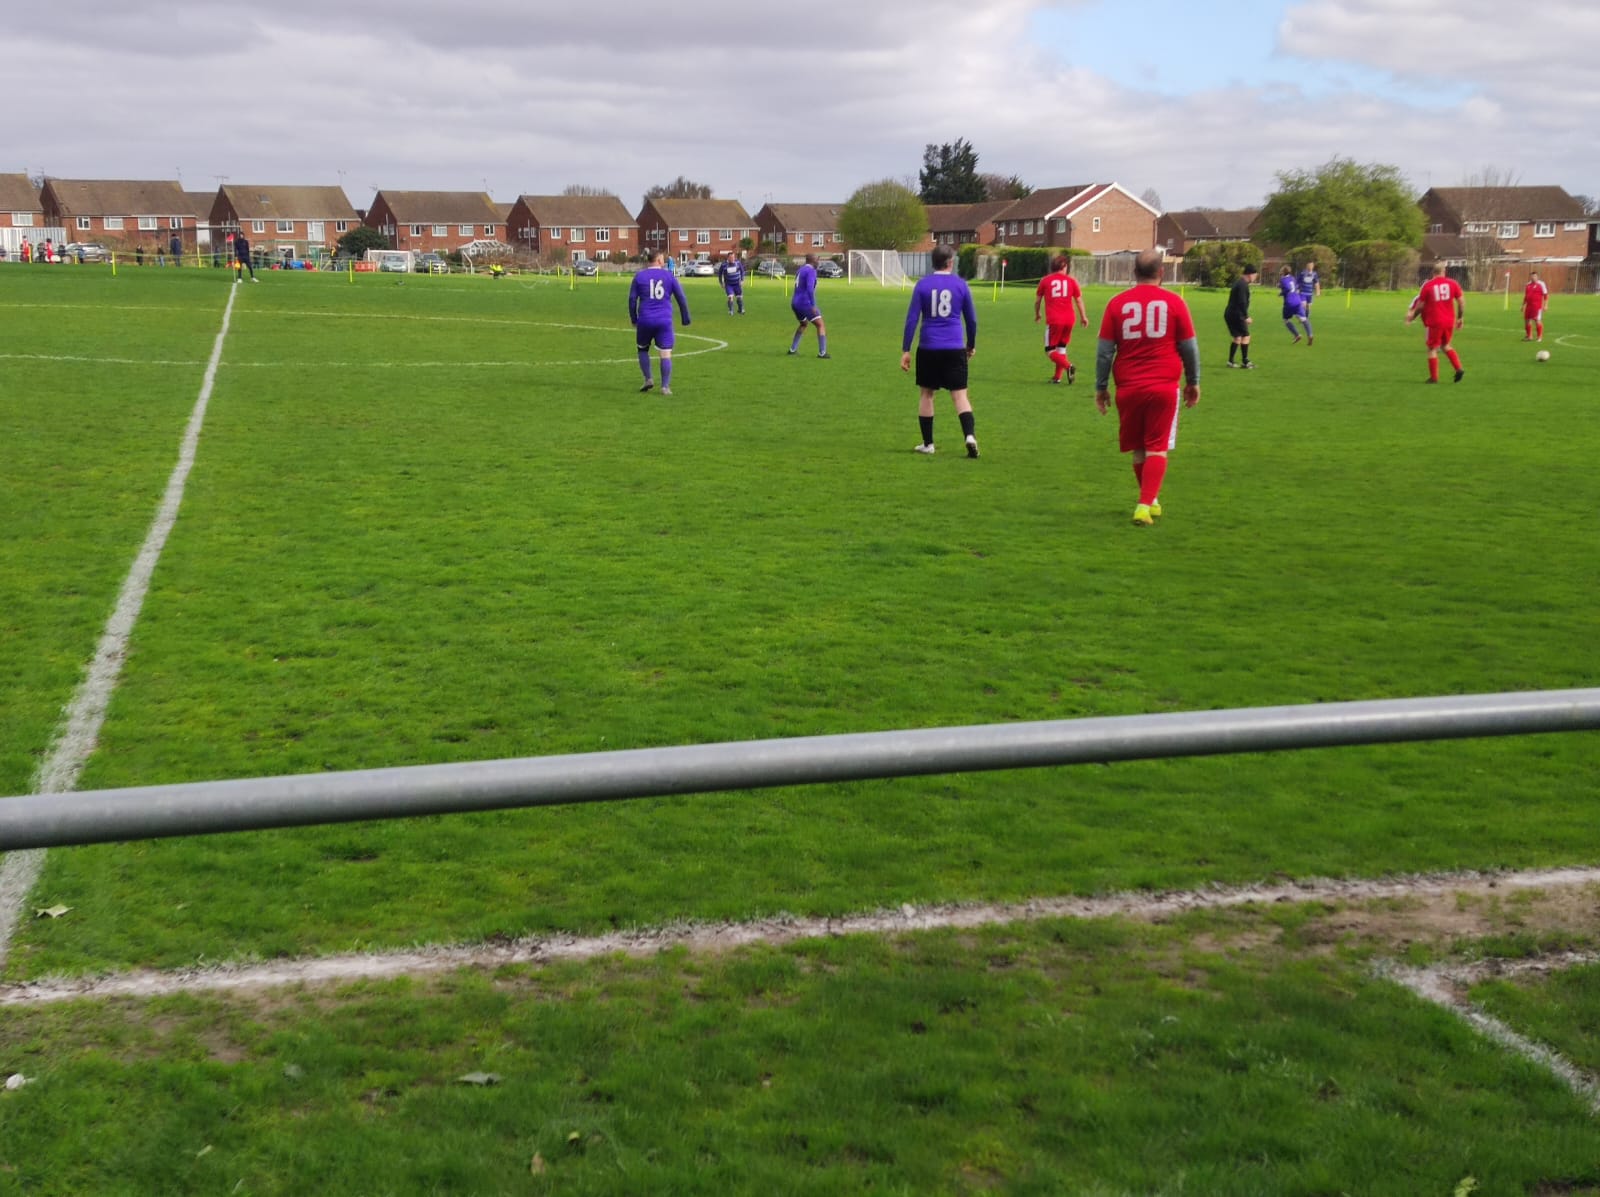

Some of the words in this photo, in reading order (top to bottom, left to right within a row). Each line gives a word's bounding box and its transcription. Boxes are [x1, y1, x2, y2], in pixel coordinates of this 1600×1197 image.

[650, 279, 665, 300] 16
[1051, 279, 1068, 298] 21
[1433, 283, 1450, 301] 19
[931, 289, 952, 318] 18
[1122, 300, 1168, 340] 20
